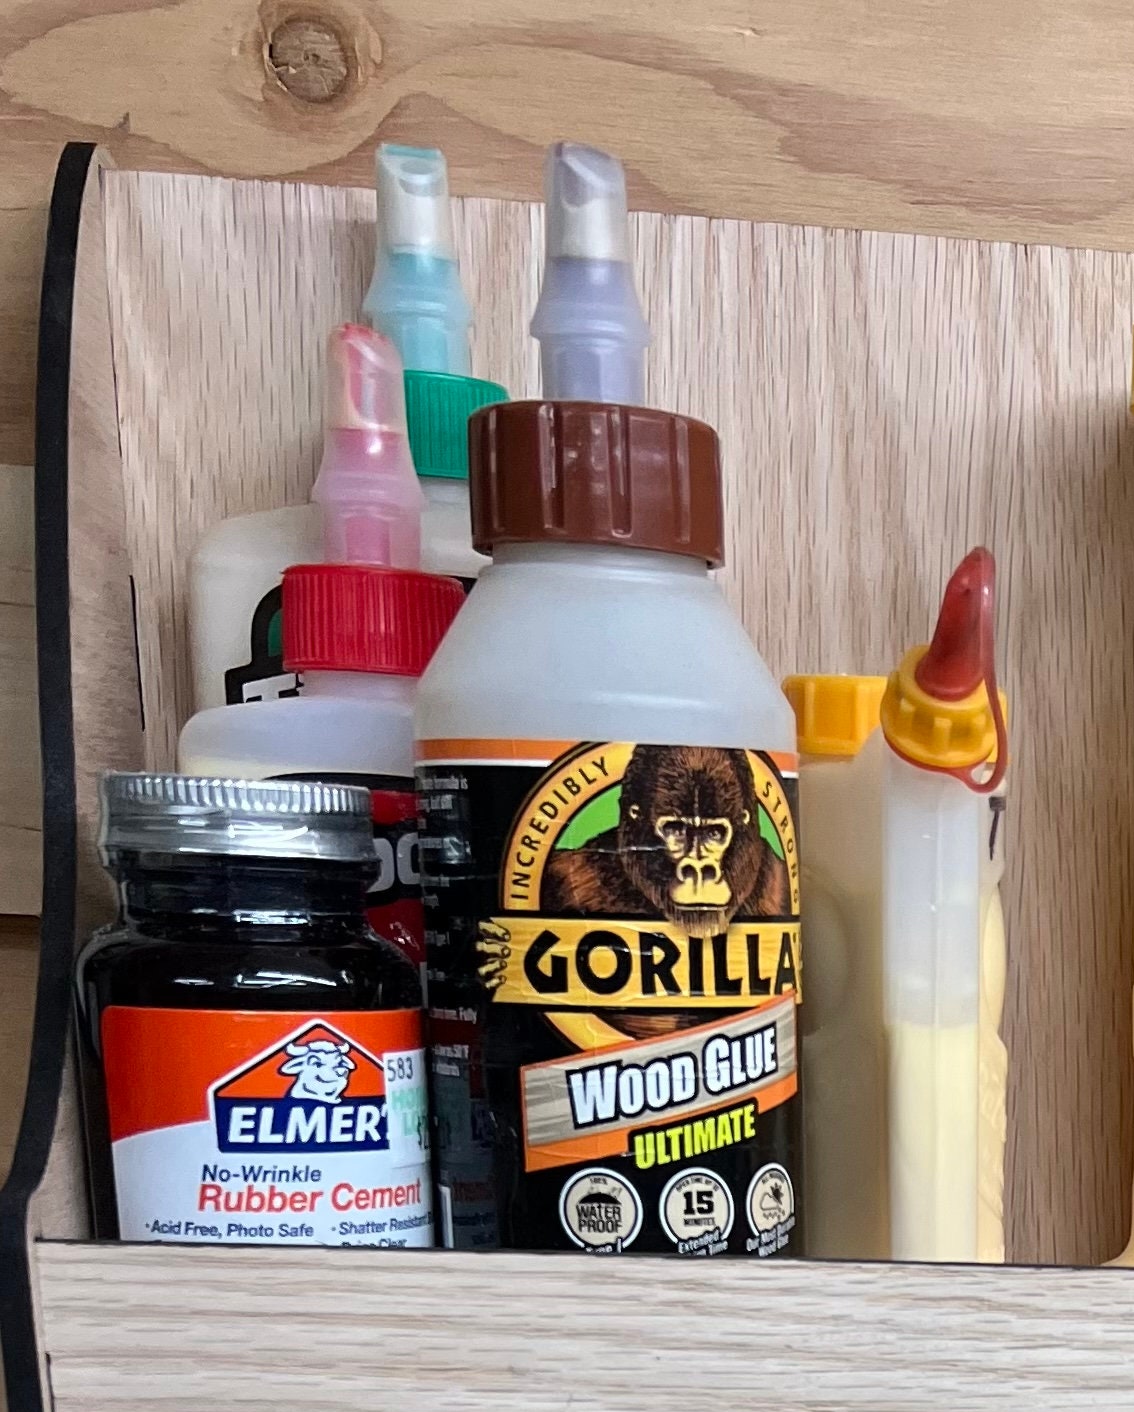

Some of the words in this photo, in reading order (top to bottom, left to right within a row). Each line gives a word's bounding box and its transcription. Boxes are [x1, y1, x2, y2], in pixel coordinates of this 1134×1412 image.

[510, 756, 609, 900] INCREDIBLY
[523, 930, 797, 996] GORILLA
[387, 1056, 413, 1081] 583
[633, 1103, 757, 1169] ULTIMATE
[201, 1163, 322, 1183] No-Wrinkle
[197, 1183, 324, 1213] Rubber
[331, 1177, 421, 1211] Cement
[683, 1190, 715, 1215] 15
[151, 1219, 182, 1235] Acid
[185, 1221, 222, 1239] Free,
[226, 1222, 274, 1238] Photo
[278, 1222, 314, 1238] Safe
[339, 1220, 388, 1236] Shatter
[578, 1219, 623, 1234] PROOF
